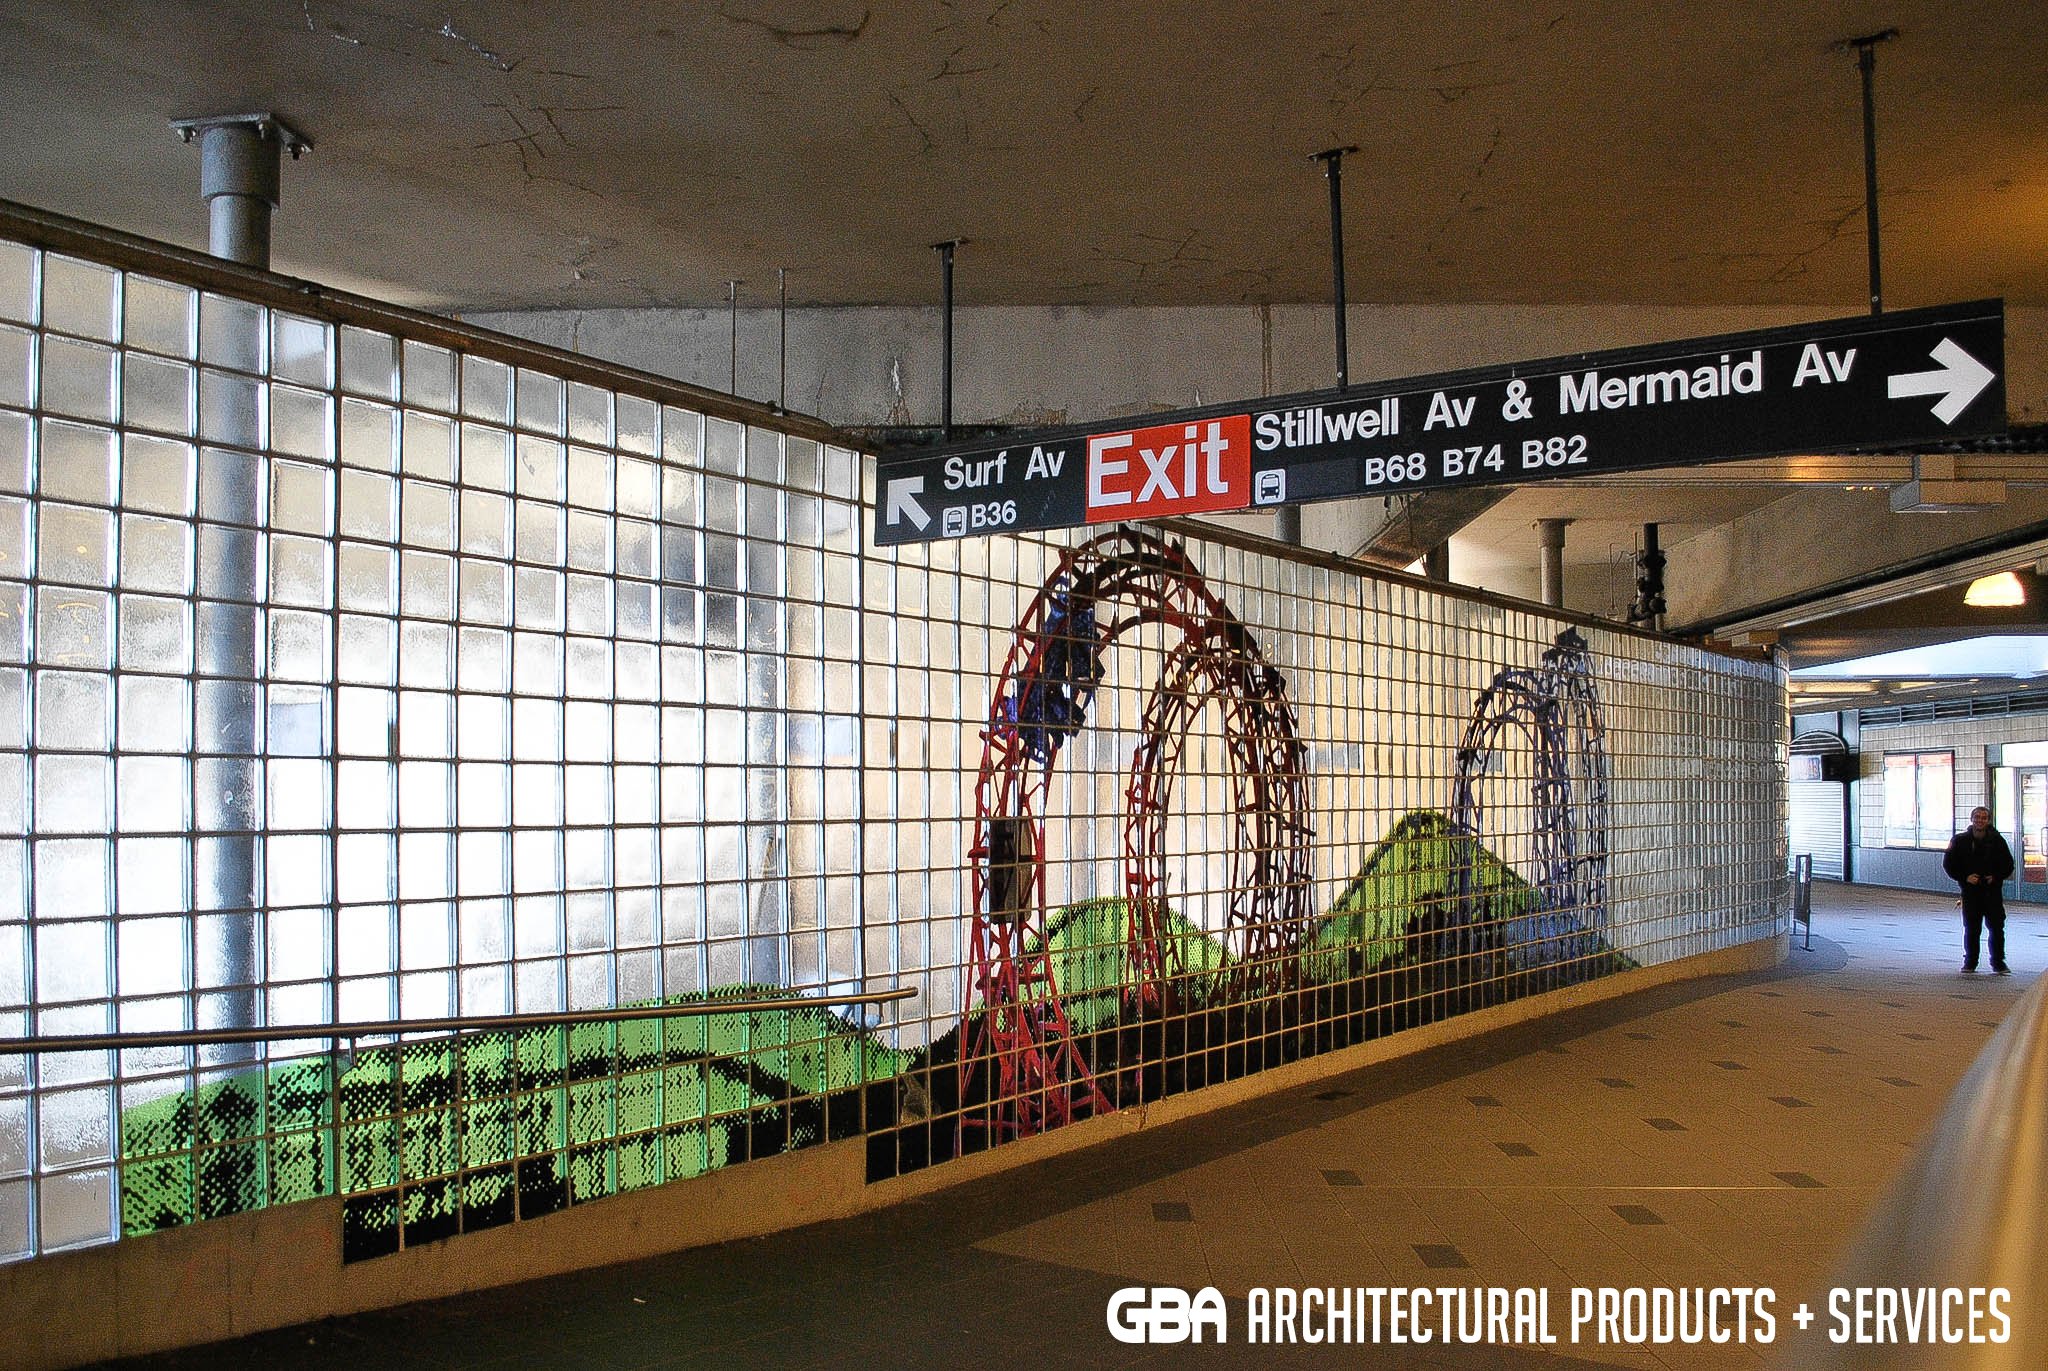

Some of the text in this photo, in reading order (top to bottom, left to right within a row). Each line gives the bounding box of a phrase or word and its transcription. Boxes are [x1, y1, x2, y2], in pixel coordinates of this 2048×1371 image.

[1256, 344, 1856, 450] Stillwell Av & Mermaid Av
[944, 447, 1065, 489] Surf Av
[1089, 421, 1228, 507] Exit
[1366, 435, 1587, 485] B68 B74 B82
[972, 500, 1016, 527] B36
